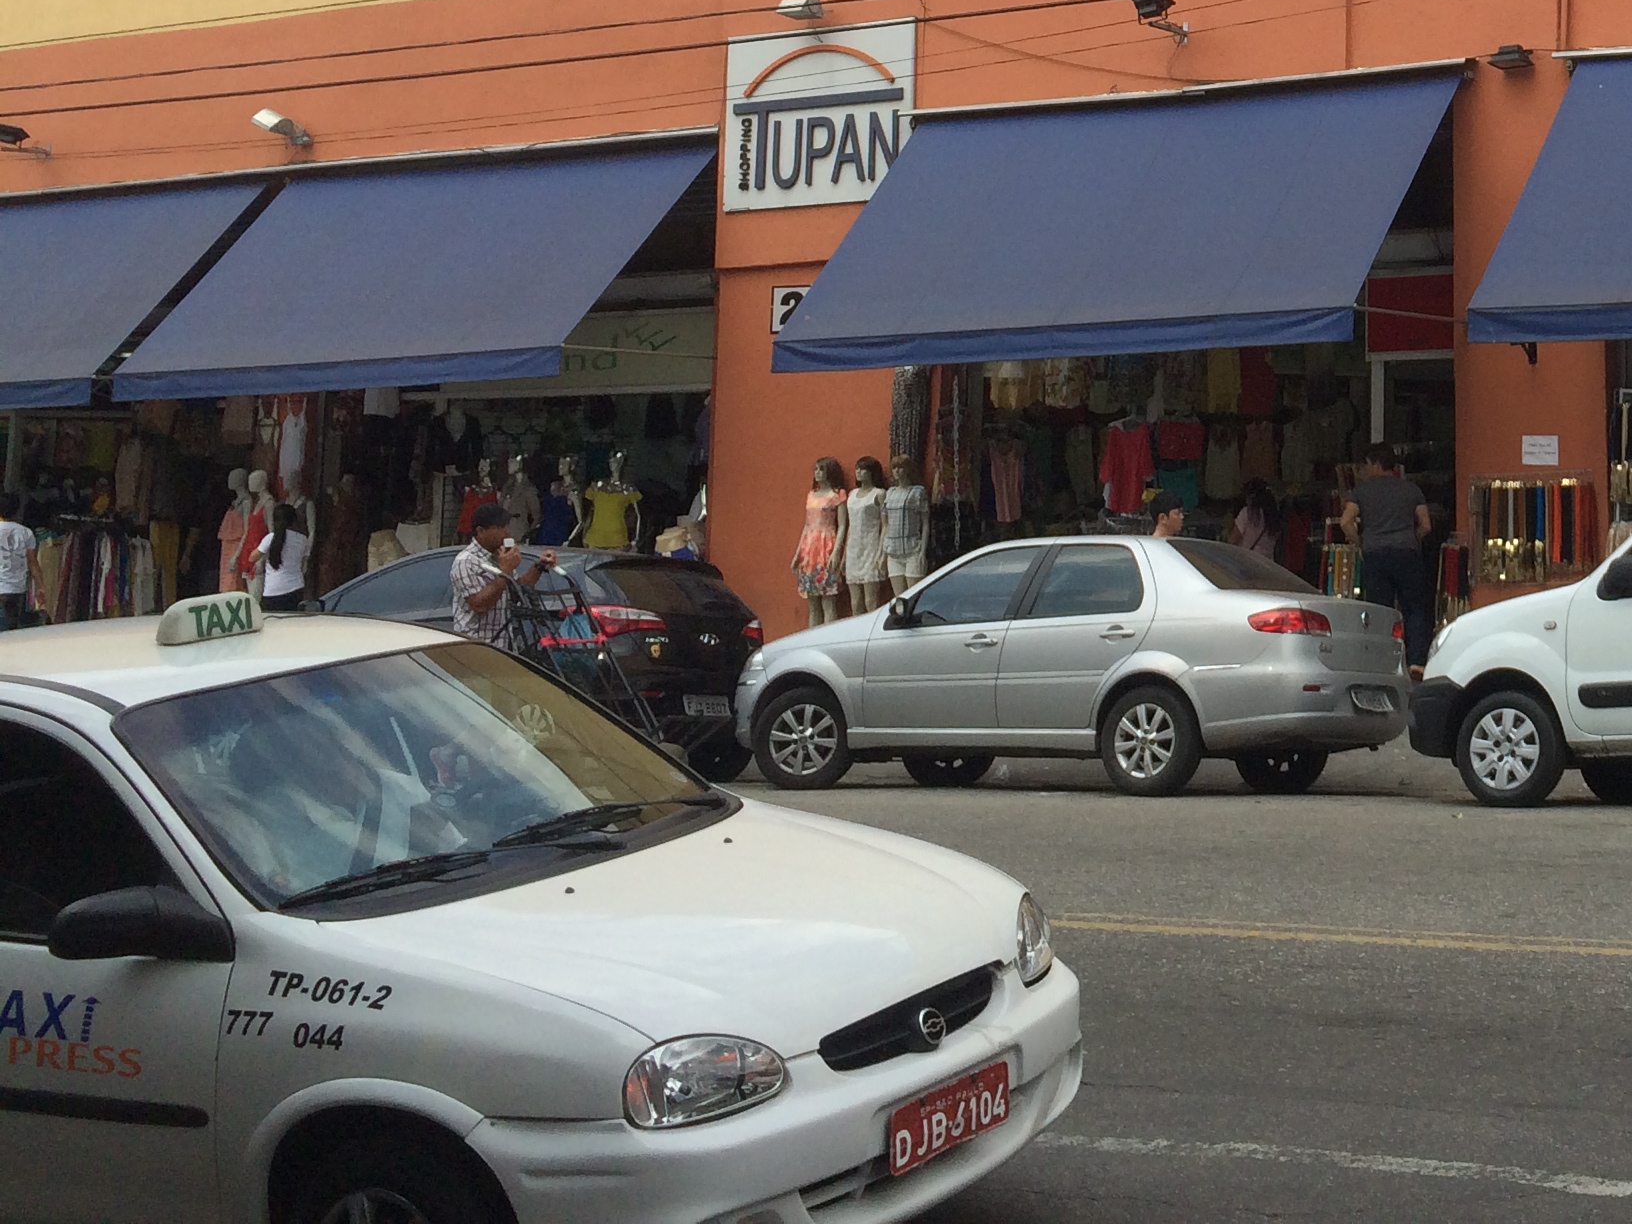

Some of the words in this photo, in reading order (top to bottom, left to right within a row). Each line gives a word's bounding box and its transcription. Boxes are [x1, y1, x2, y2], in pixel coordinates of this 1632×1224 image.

[733, 87, 904, 193] TUPAN
[738, 117, 753, 192] SHOPPING
[188, 597, 253, 638] TAXI
[267, 969, 393, 1011] TP-061-2
[226, 1008, 274, 1038] 777
[292, 1022, 345, 1052] 044
